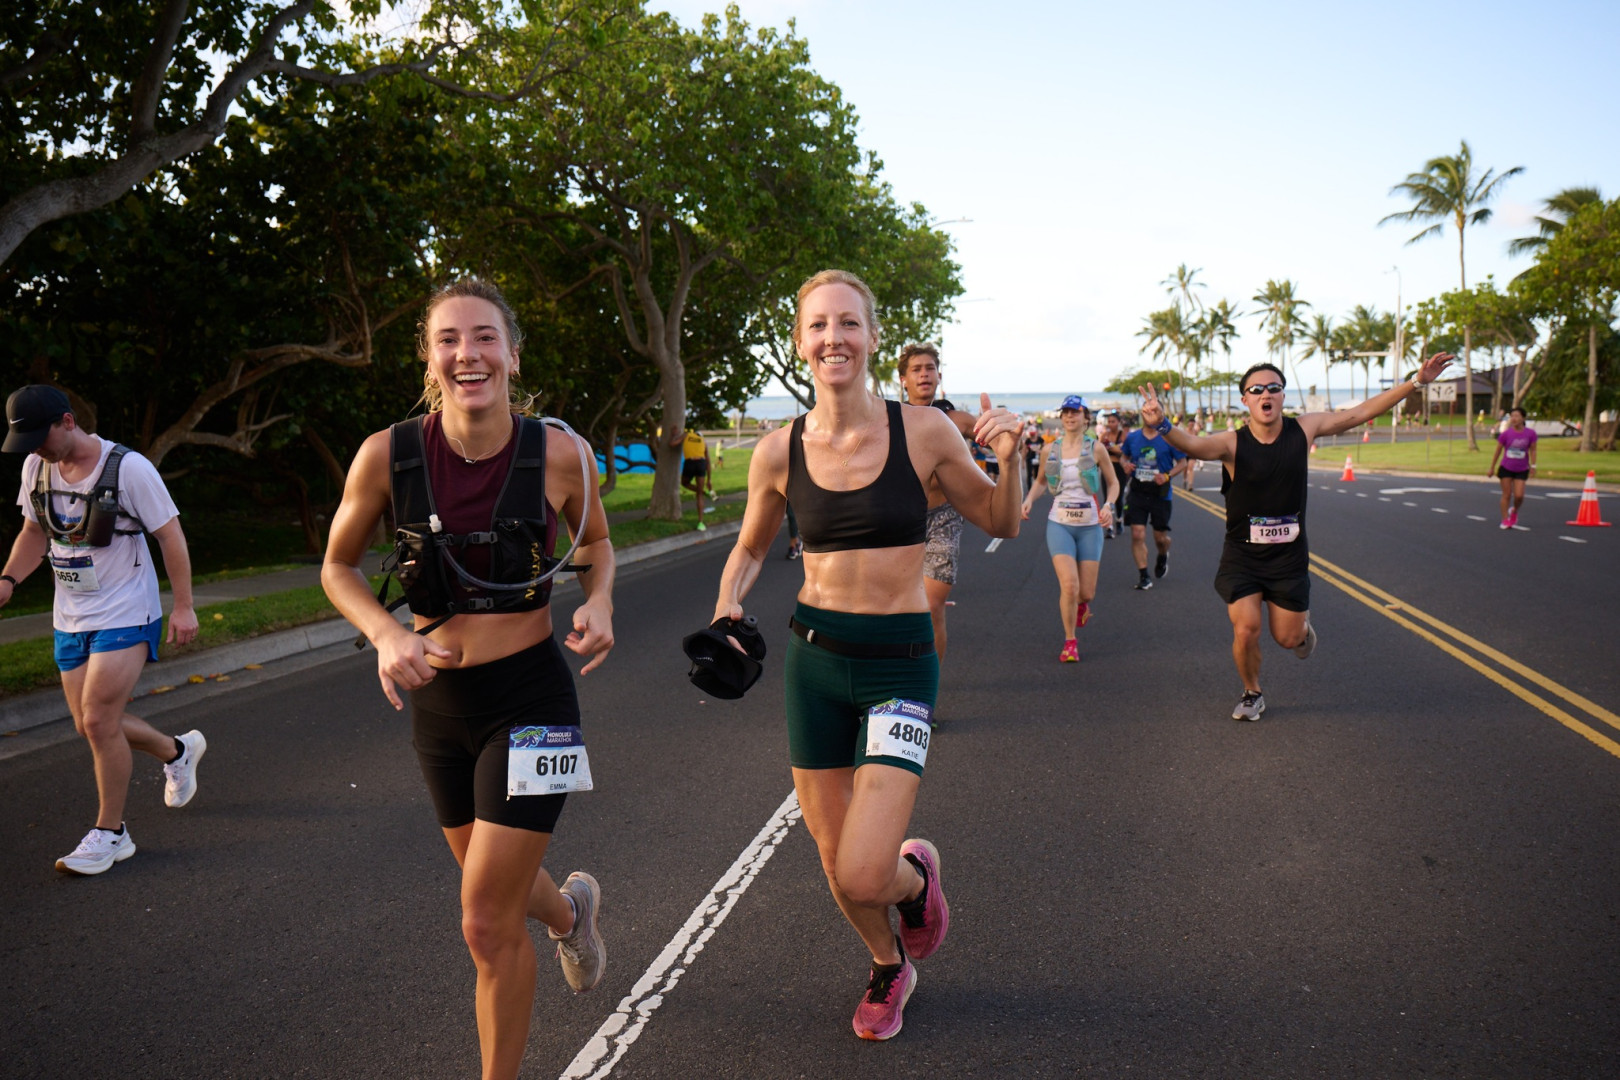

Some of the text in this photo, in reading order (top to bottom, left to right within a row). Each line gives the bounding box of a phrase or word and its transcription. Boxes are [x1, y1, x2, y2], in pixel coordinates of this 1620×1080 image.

[1259, 526, 1290, 537] 12019
[901, 708, 928, 720] MARATHON
[888, 721, 929, 750] 4803
[901, 748, 919, 760] KATIE
[535, 754, 578, 776] 6107
[549, 783, 567, 791] EMMA
